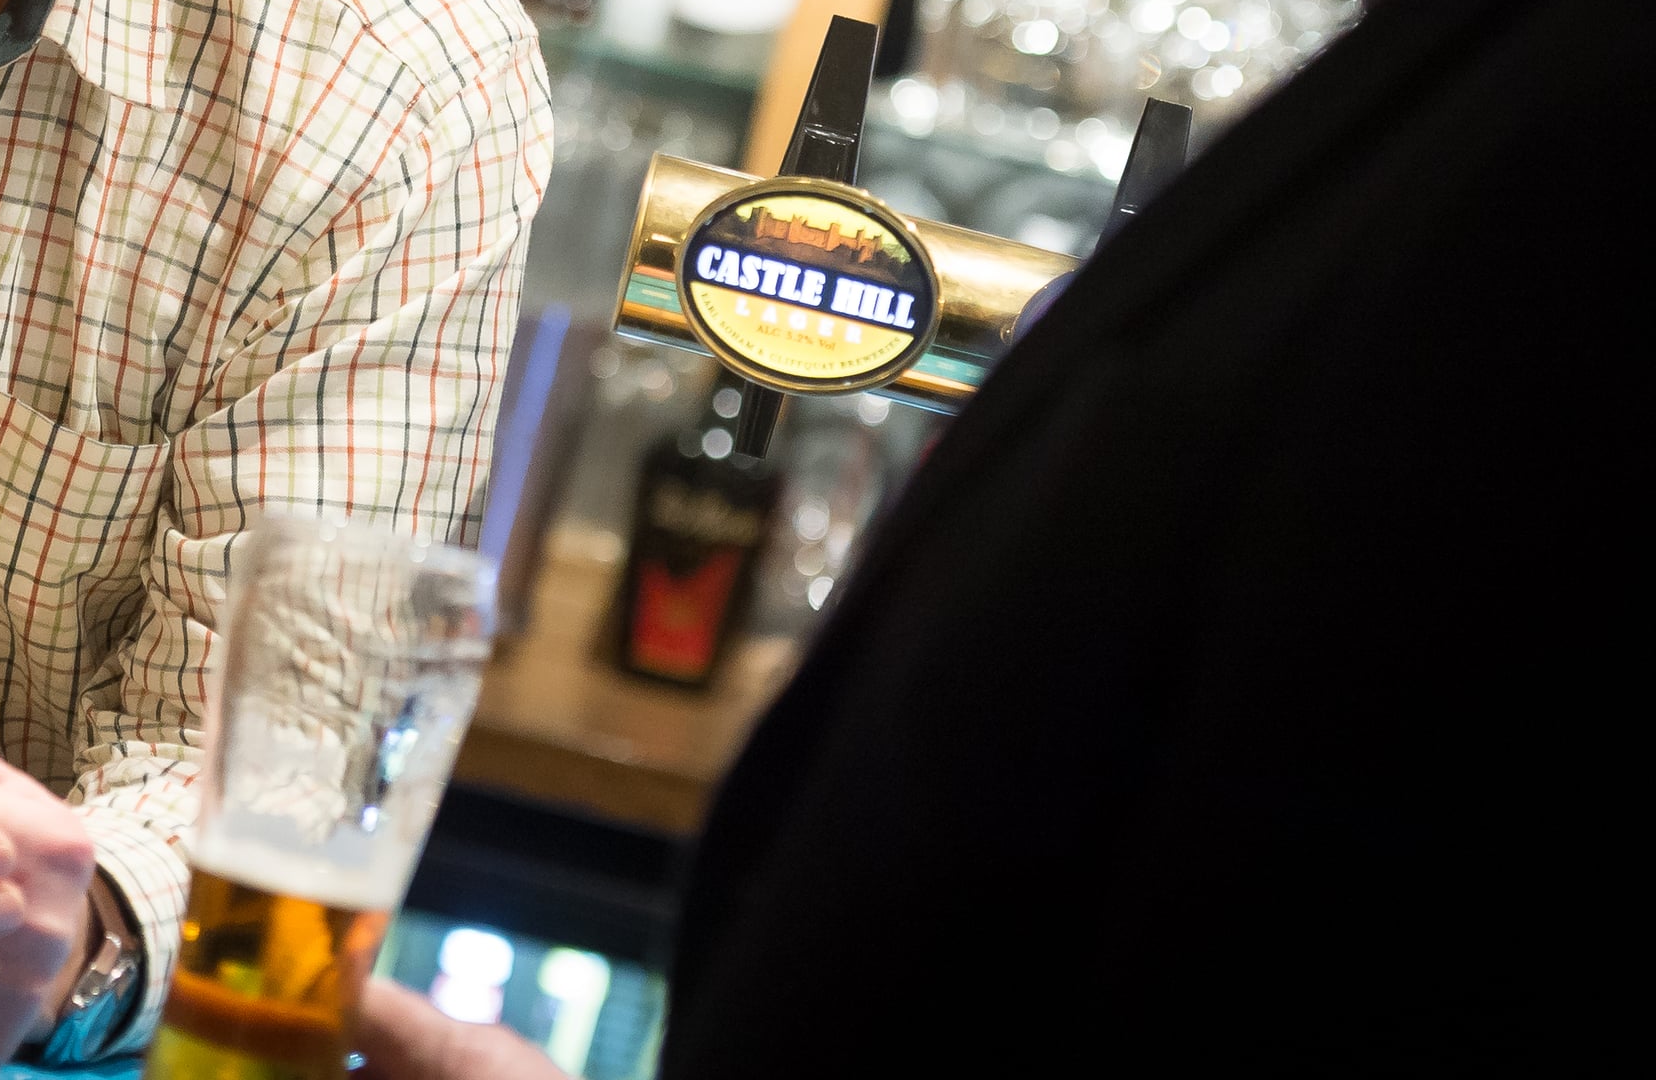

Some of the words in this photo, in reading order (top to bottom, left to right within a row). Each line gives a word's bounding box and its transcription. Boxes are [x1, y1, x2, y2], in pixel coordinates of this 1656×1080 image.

[696, 245, 825, 307] CASTLE
[830, 277, 915, 329] HILL
[735, 295, 862, 344] LAGER
[756, 324, 782, 337] ALC
[818, 338, 837, 351] Vol
